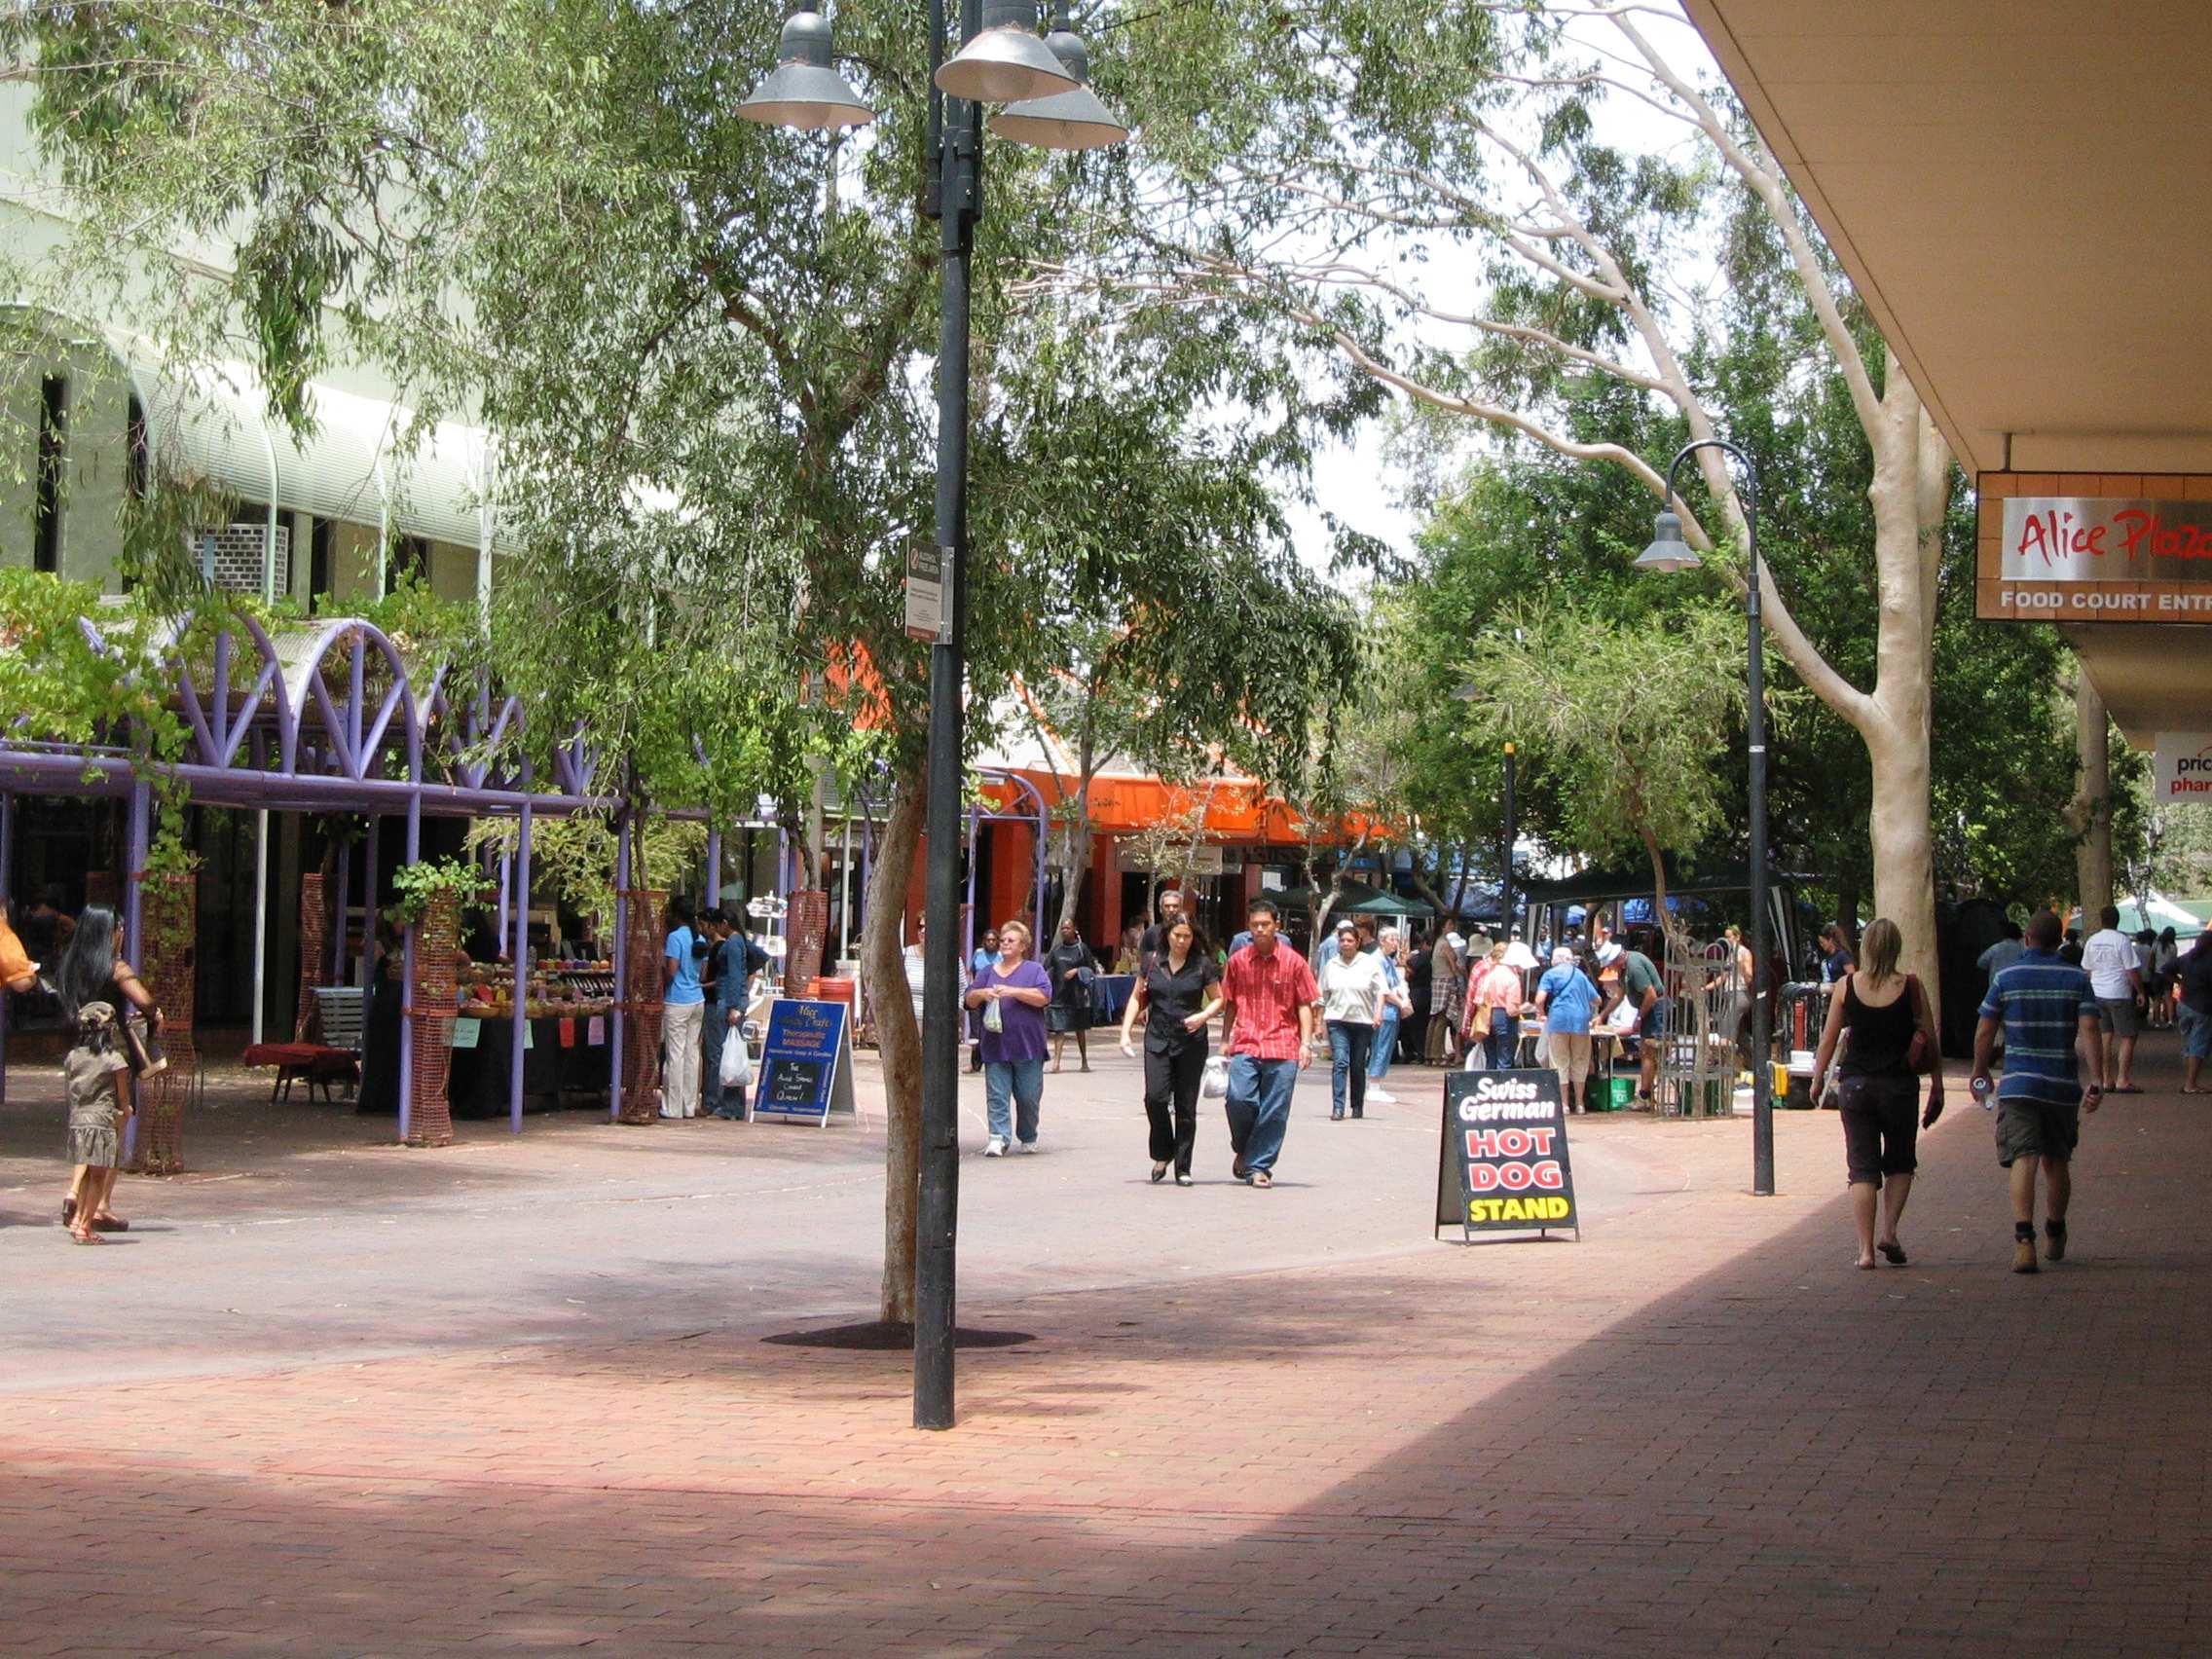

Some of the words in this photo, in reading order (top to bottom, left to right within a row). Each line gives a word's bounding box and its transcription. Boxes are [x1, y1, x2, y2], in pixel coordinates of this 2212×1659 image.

[2018, 509, 2108, 567] Alice
[2001, 590, 2063, 608] FOOD
[2072, 592, 2151, 610] COURT
[1476, 1077, 1538, 1102] Swiss
[1458, 1095, 1556, 1122] German
[1465, 1127, 1556, 1159] HOT
[1468, 1160, 1564, 1192] DOG
[1469, 1197, 1569, 1222] STAND
